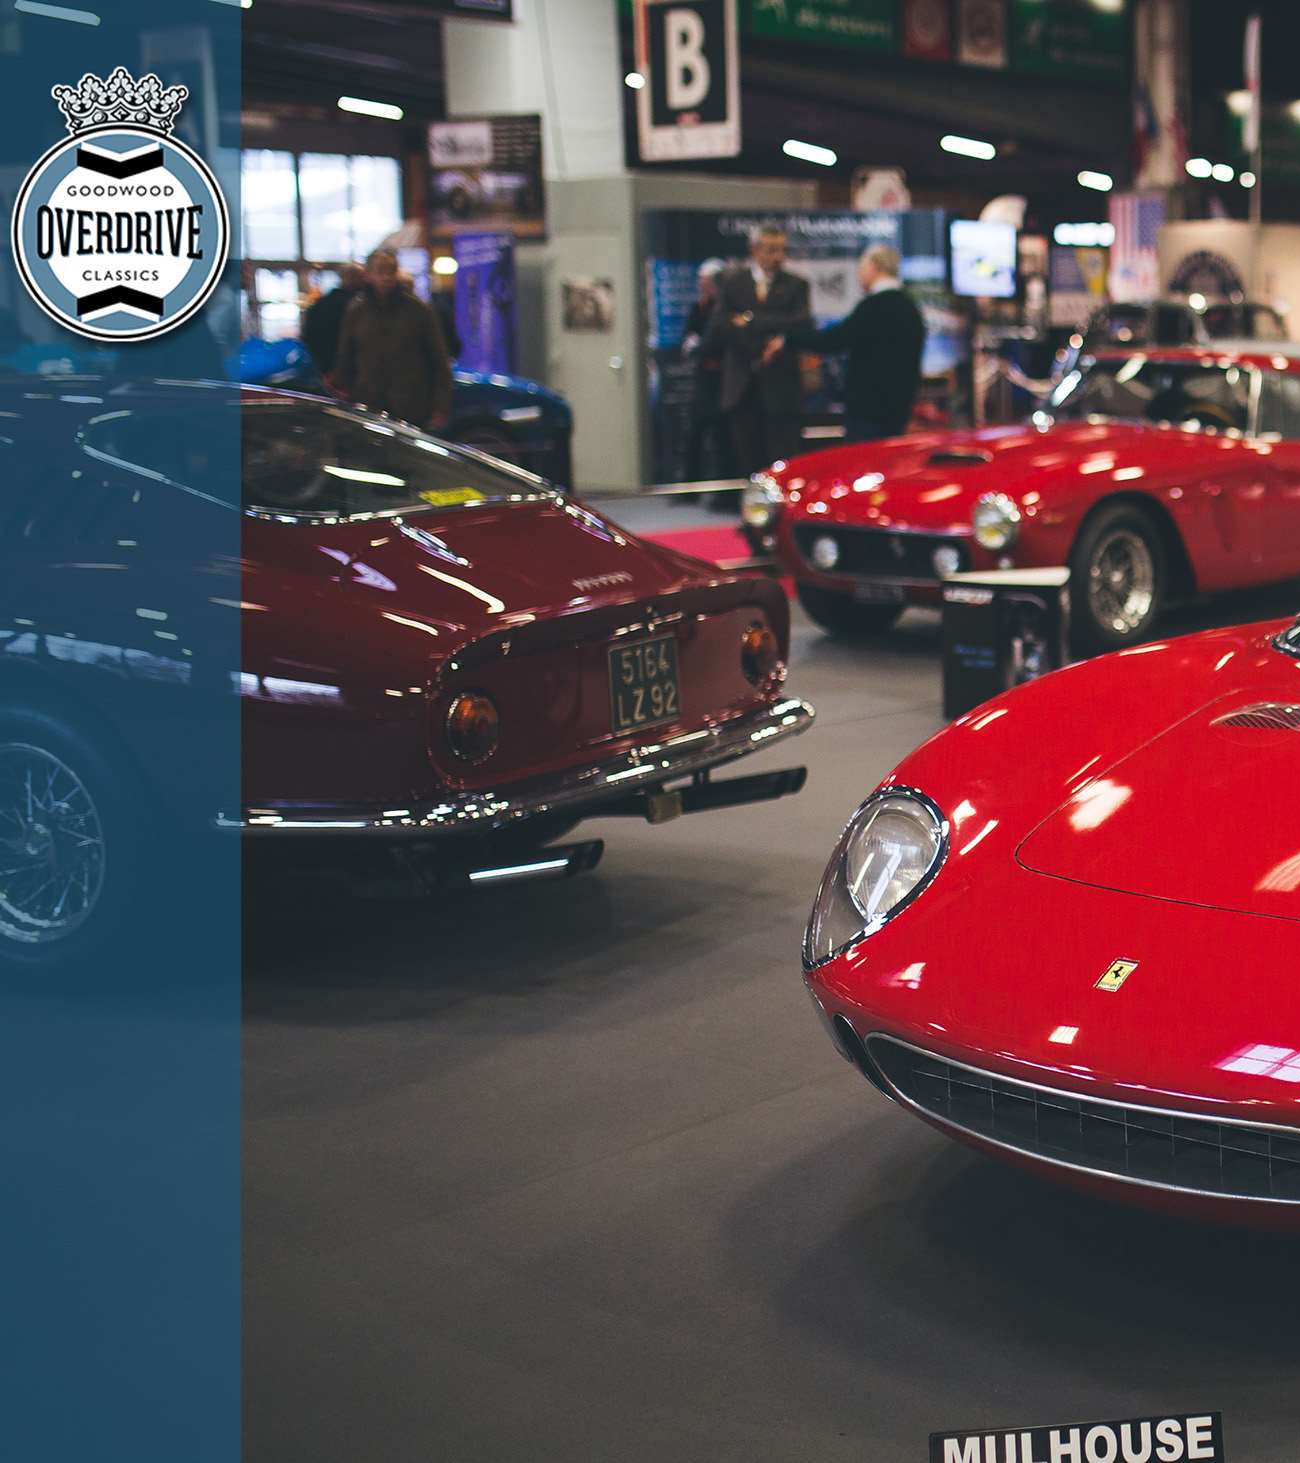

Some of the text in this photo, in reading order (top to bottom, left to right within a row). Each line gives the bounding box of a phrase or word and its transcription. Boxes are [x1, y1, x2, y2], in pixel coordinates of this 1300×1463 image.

[664, 8, 711, 109] B
[621, 643, 670, 685] 5164
[618, 681, 677, 726] LZ 92
[943, 1415, 1215, 1463] MULHOUSE
